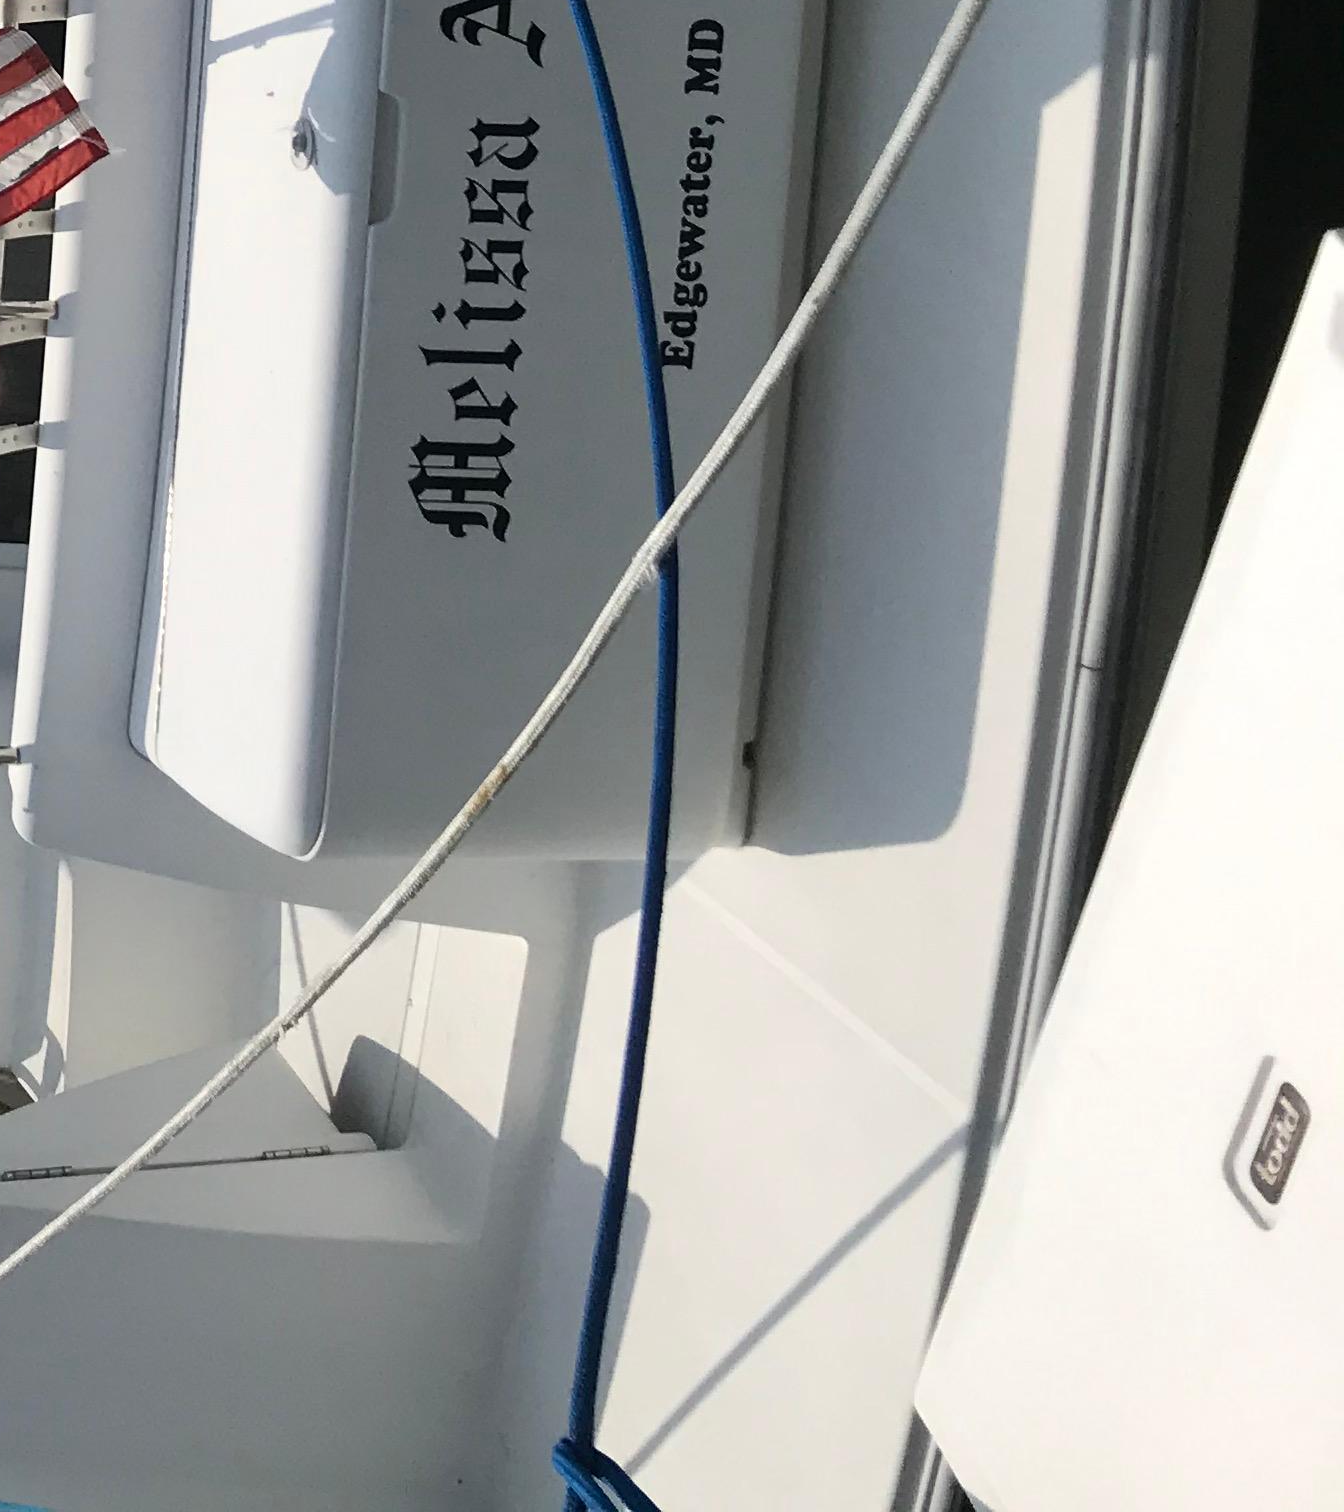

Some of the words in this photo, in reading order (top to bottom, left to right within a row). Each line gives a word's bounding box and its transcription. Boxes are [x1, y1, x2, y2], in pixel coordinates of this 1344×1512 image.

[684, 18, 724, 96] MD
[407, 116, 540, 543] Melissa
[659, 115, 725, 370] Edgewater,
